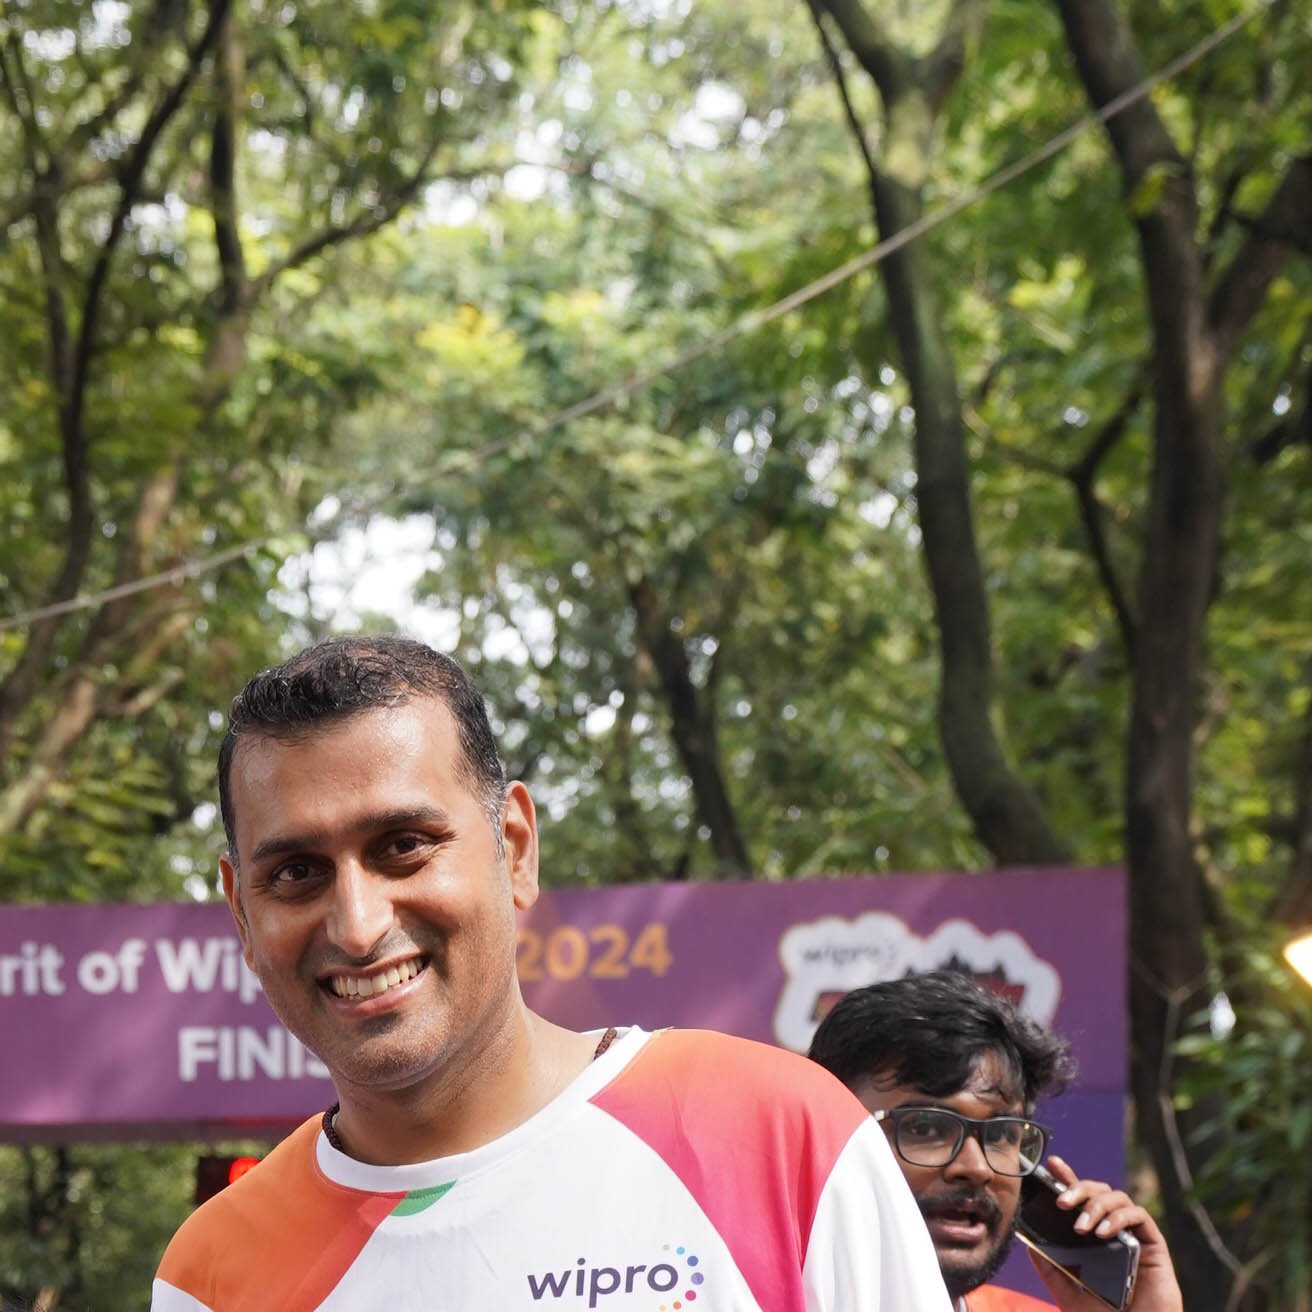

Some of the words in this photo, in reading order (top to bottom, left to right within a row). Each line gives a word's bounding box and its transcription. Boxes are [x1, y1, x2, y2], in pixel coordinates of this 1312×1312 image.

[77, 938, 147, 996] of
[516, 922, 673, 982] 2024
[527, 1257, 678, 1308] wipro
